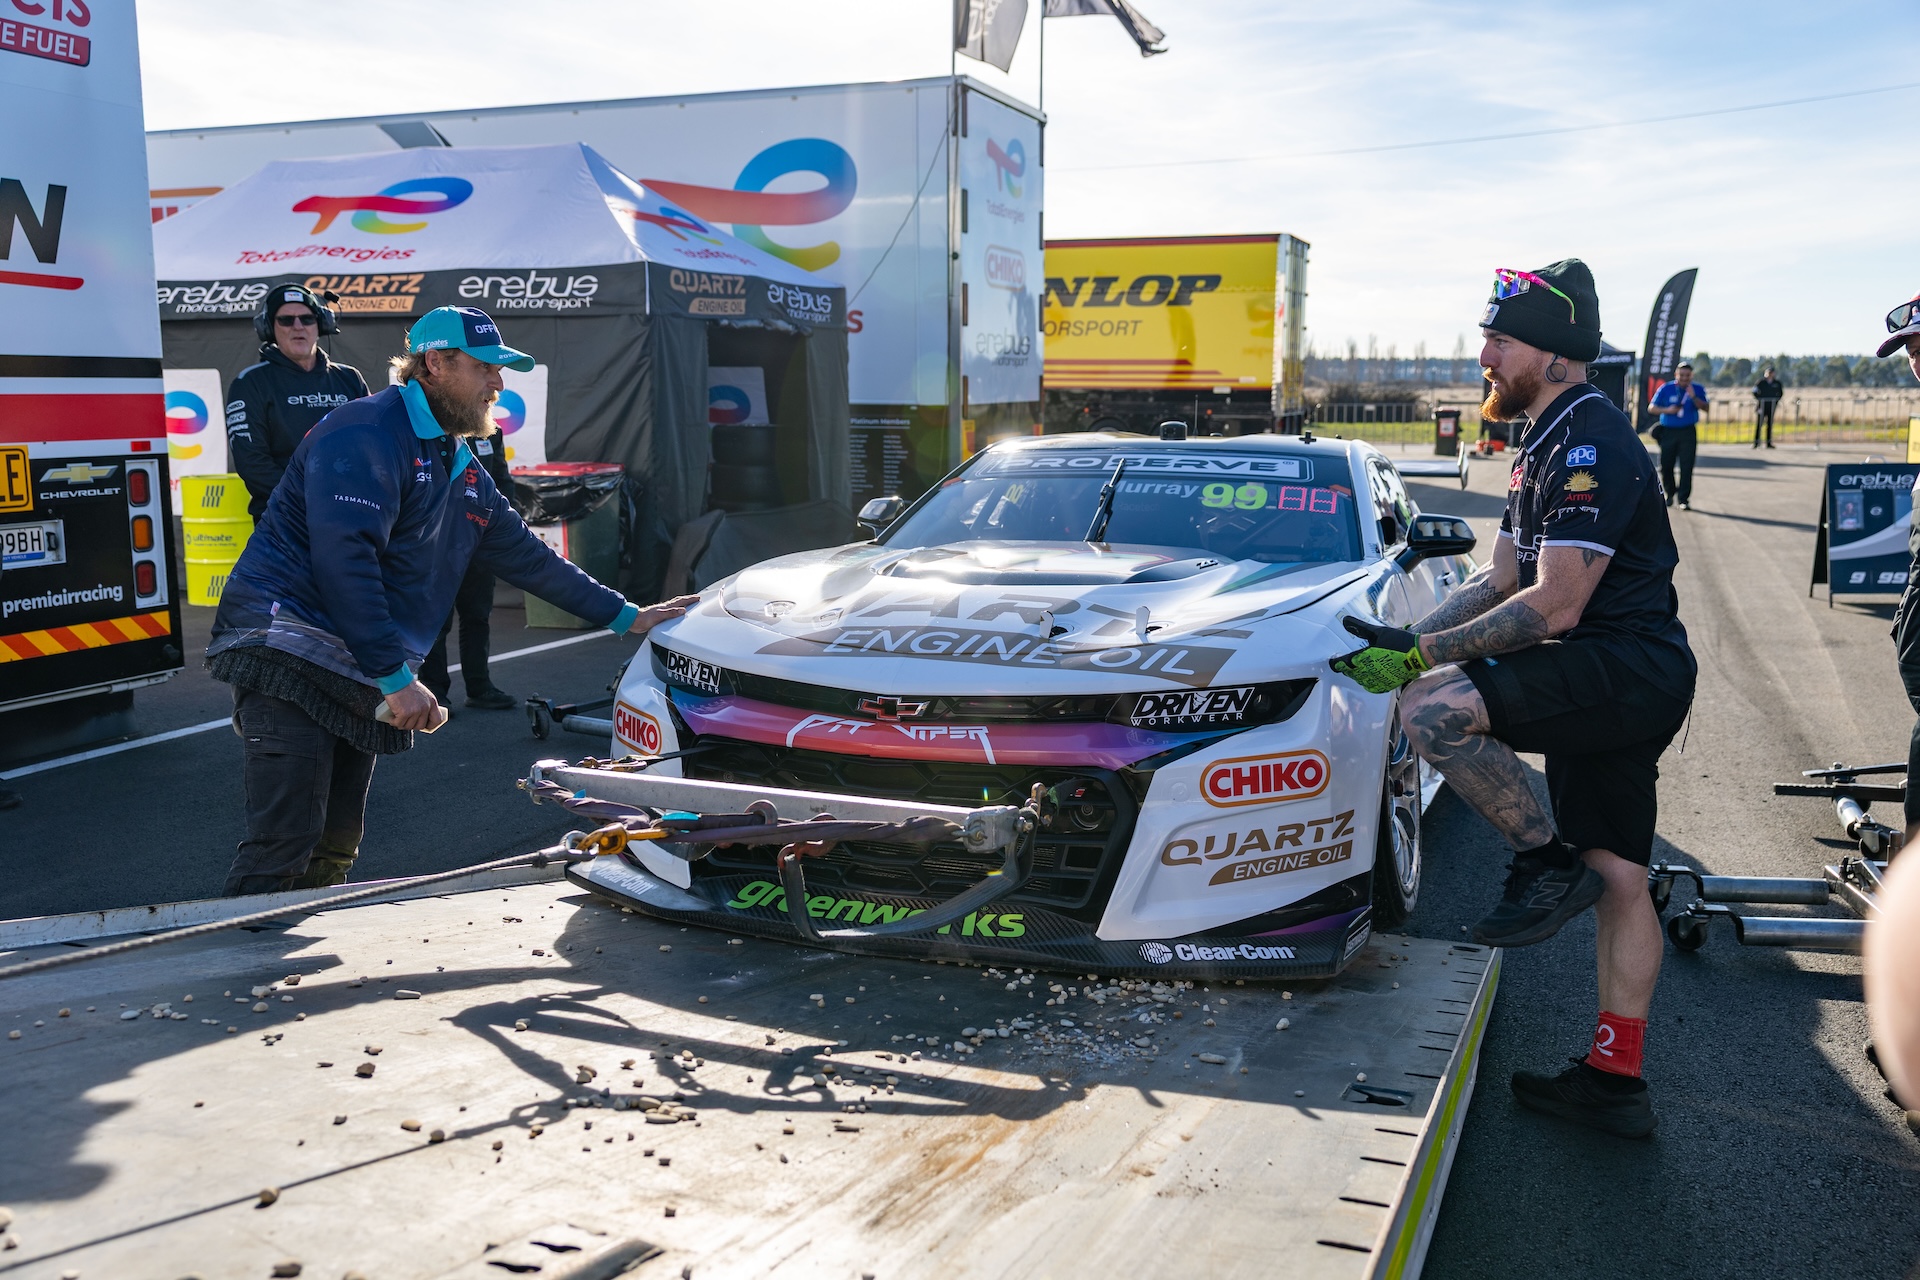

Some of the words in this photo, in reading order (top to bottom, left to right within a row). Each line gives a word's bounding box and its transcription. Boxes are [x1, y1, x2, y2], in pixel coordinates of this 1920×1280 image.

[21, 26, 81, 60] FUEL
[235, 244, 417, 264] TotalEnergies
[987, 253, 1023, 283] CHIKO
[157, 281, 269, 304] erebus
[304, 273, 425, 296] QUARTZ
[458, 270, 599, 298] erebus
[670, 269, 746, 295] QUARTZ
[175, 300, 260, 314] motorsport
[341, 298, 385, 310] ENGINE
[388, 296, 409, 309] OIL
[496, 296, 593, 311] motorsport
[698, 301, 727, 313] ENGINE
[730, 302, 743, 313] OIL
[767, 284, 832, 313] erebus
[426, 340, 448, 349] Coates
[976, 328, 1030, 356] erebus
[1650, 292, 1674, 374] SUPERCARS
[1661, 323, 1679, 374] TRAVEL
[287, 392, 349, 405] erebus
[1569, 448, 1594, 464] PPG
[1839, 471, 1915, 487] erebus
[40, 487, 121, 500] CHEVROLET
[334, 494, 381, 511] TASMANIAN
[1201, 483, 1268, 510] 99
[1565, 493, 1594, 502] Army
[1849, 571, 1866, 584] 9
[1877, 571, 1909, 584] 99
[3, 582, 123, 618] premiairracing
[824, 628, 1065, 666] ENGINE
[1088, 646, 1196, 676] OIL
[667, 652, 721, 687] DRIVEN
[667, 671, 720, 695] WORKWEAR
[1130, 688, 1255, 718] DRIVEN
[616, 708, 658, 751] CHIKO
[1131, 712, 1244, 727] WORKWEAR
[786, 713, 876, 748] PIT
[891, 725, 997, 765] VIPER
[1209, 759, 1323, 799] CHIKO
[1160, 809, 1355, 867] QUARTZ
[1232, 851, 1310, 880] ENGINE
[1316, 844, 1347, 864] OIL
[1174, 943, 1293, 961] Clear-Com
[1596, 1023, 1616, 1057] 2
